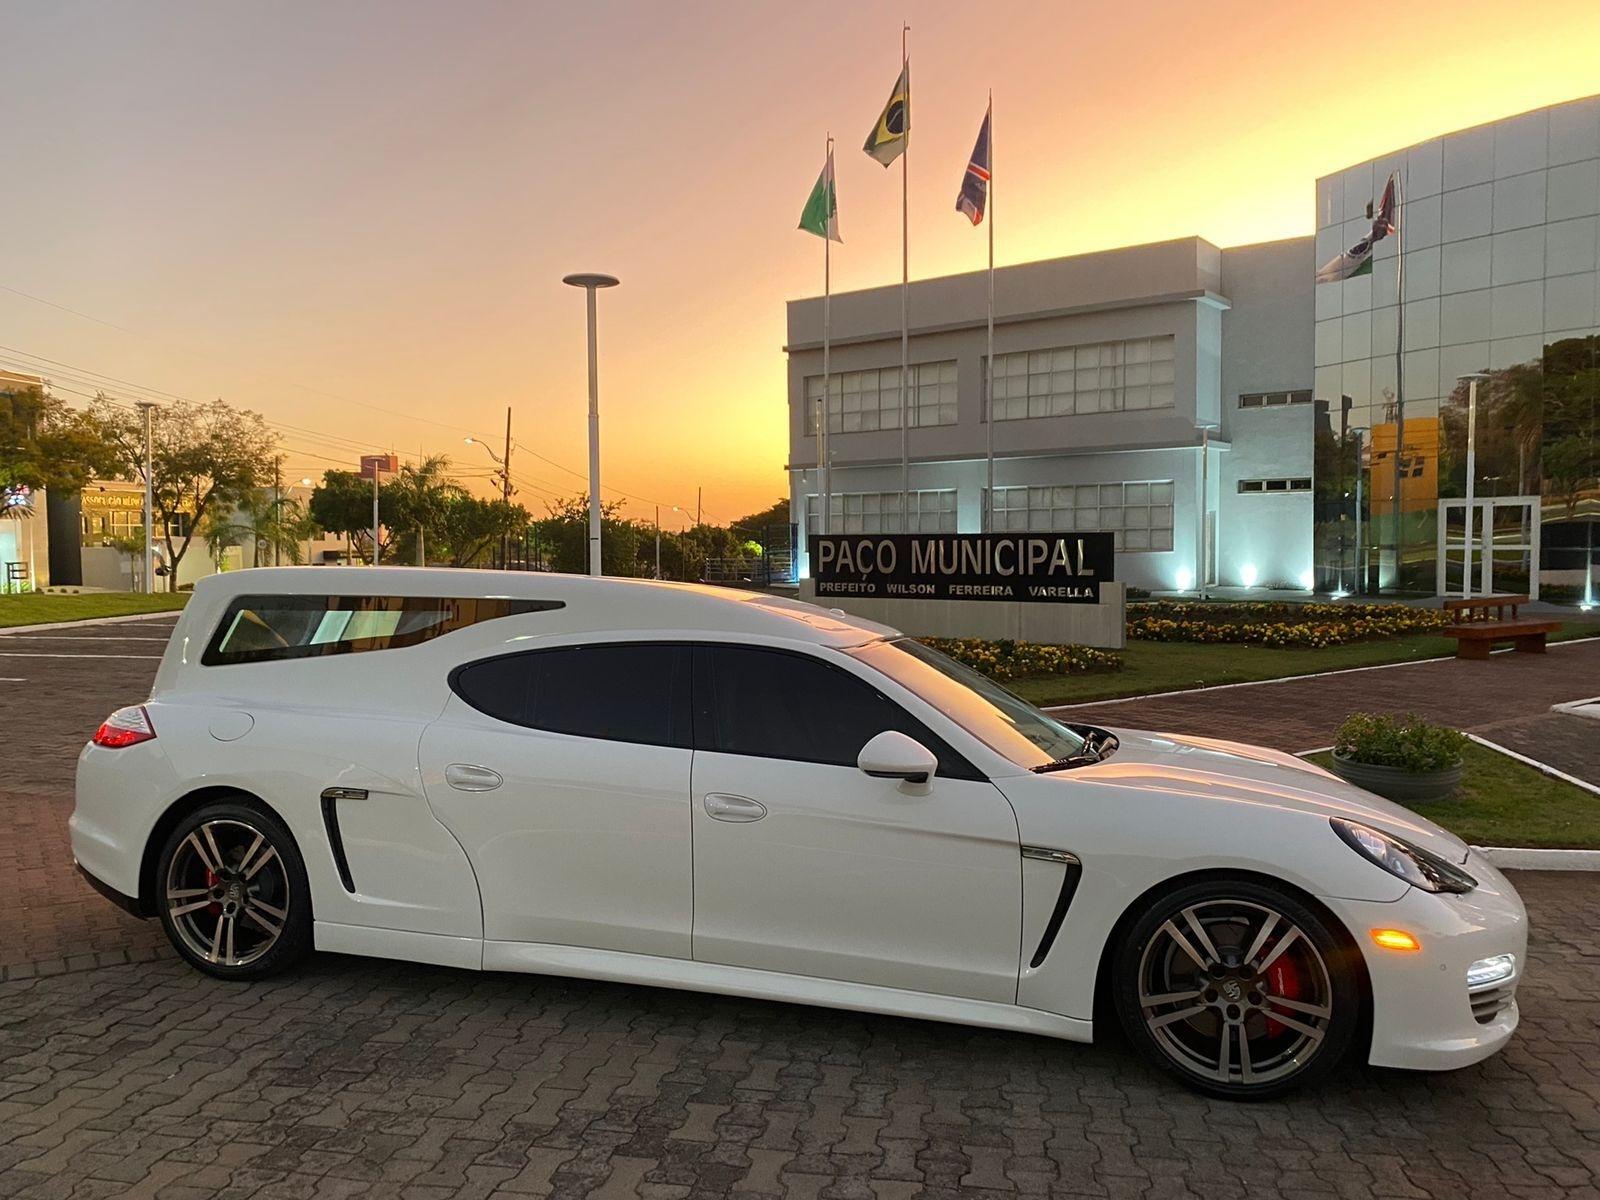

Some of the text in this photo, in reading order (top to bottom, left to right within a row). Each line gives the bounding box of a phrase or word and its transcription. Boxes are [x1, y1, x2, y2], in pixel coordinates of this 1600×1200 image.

[818, 538, 1094, 581] PAÇO MUNICIPAL
[820, 582, 1094, 598] PREFEITO WILSON FERREIRA VARELLA
